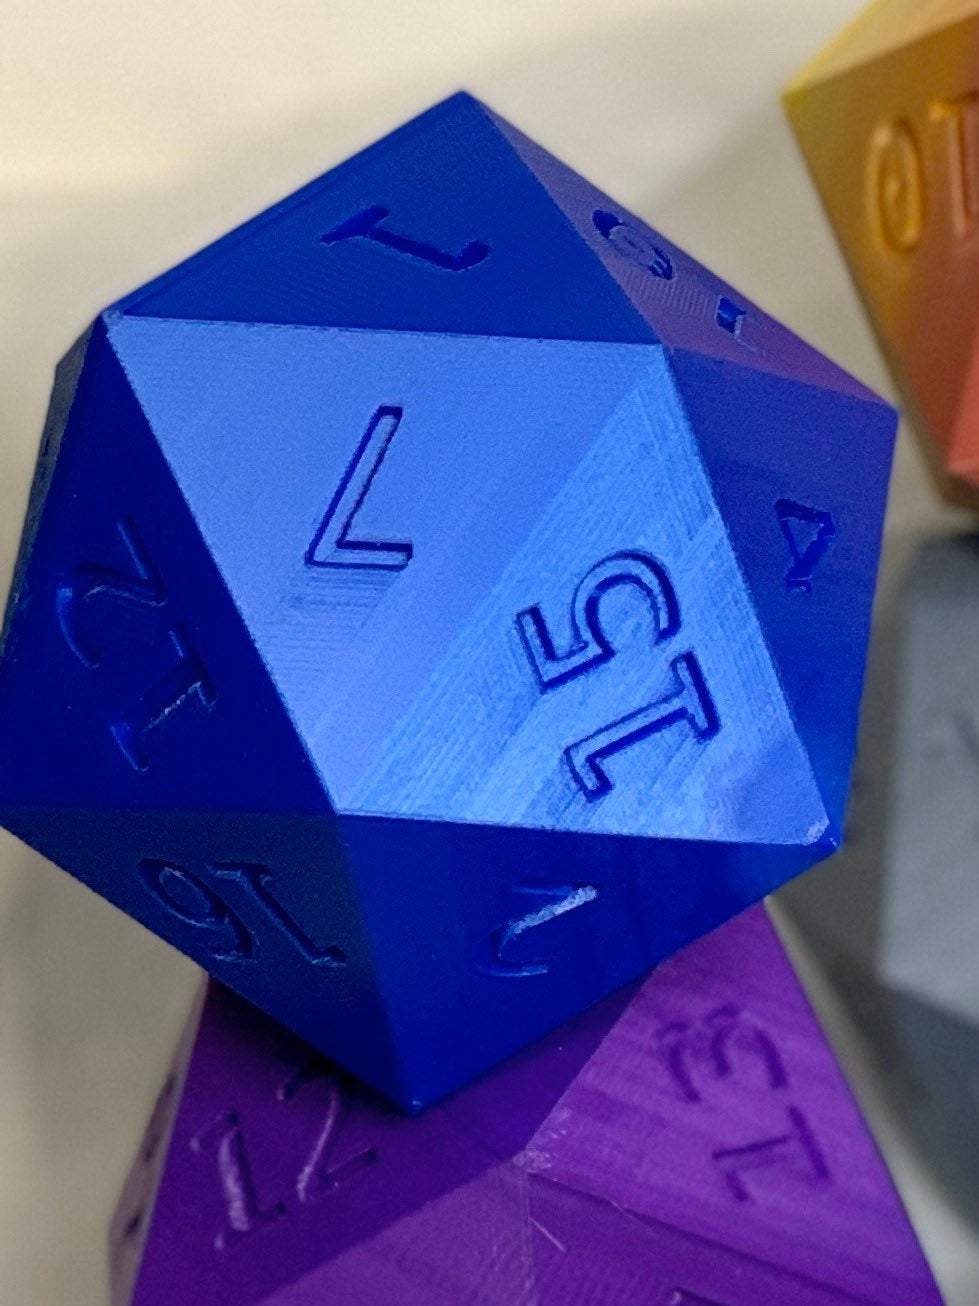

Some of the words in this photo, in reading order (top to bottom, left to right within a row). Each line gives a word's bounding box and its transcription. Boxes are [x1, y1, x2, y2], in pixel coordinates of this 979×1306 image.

[320, 205, 490, 271] 1
[304, 404, 414, 570] 7
[775, 497, 836, 594] 4
[515, 550, 721, 802] 15
[137, 858, 347, 968] 16
[477, 877, 598, 977] 2
[653, 1004, 831, 1202] 13
